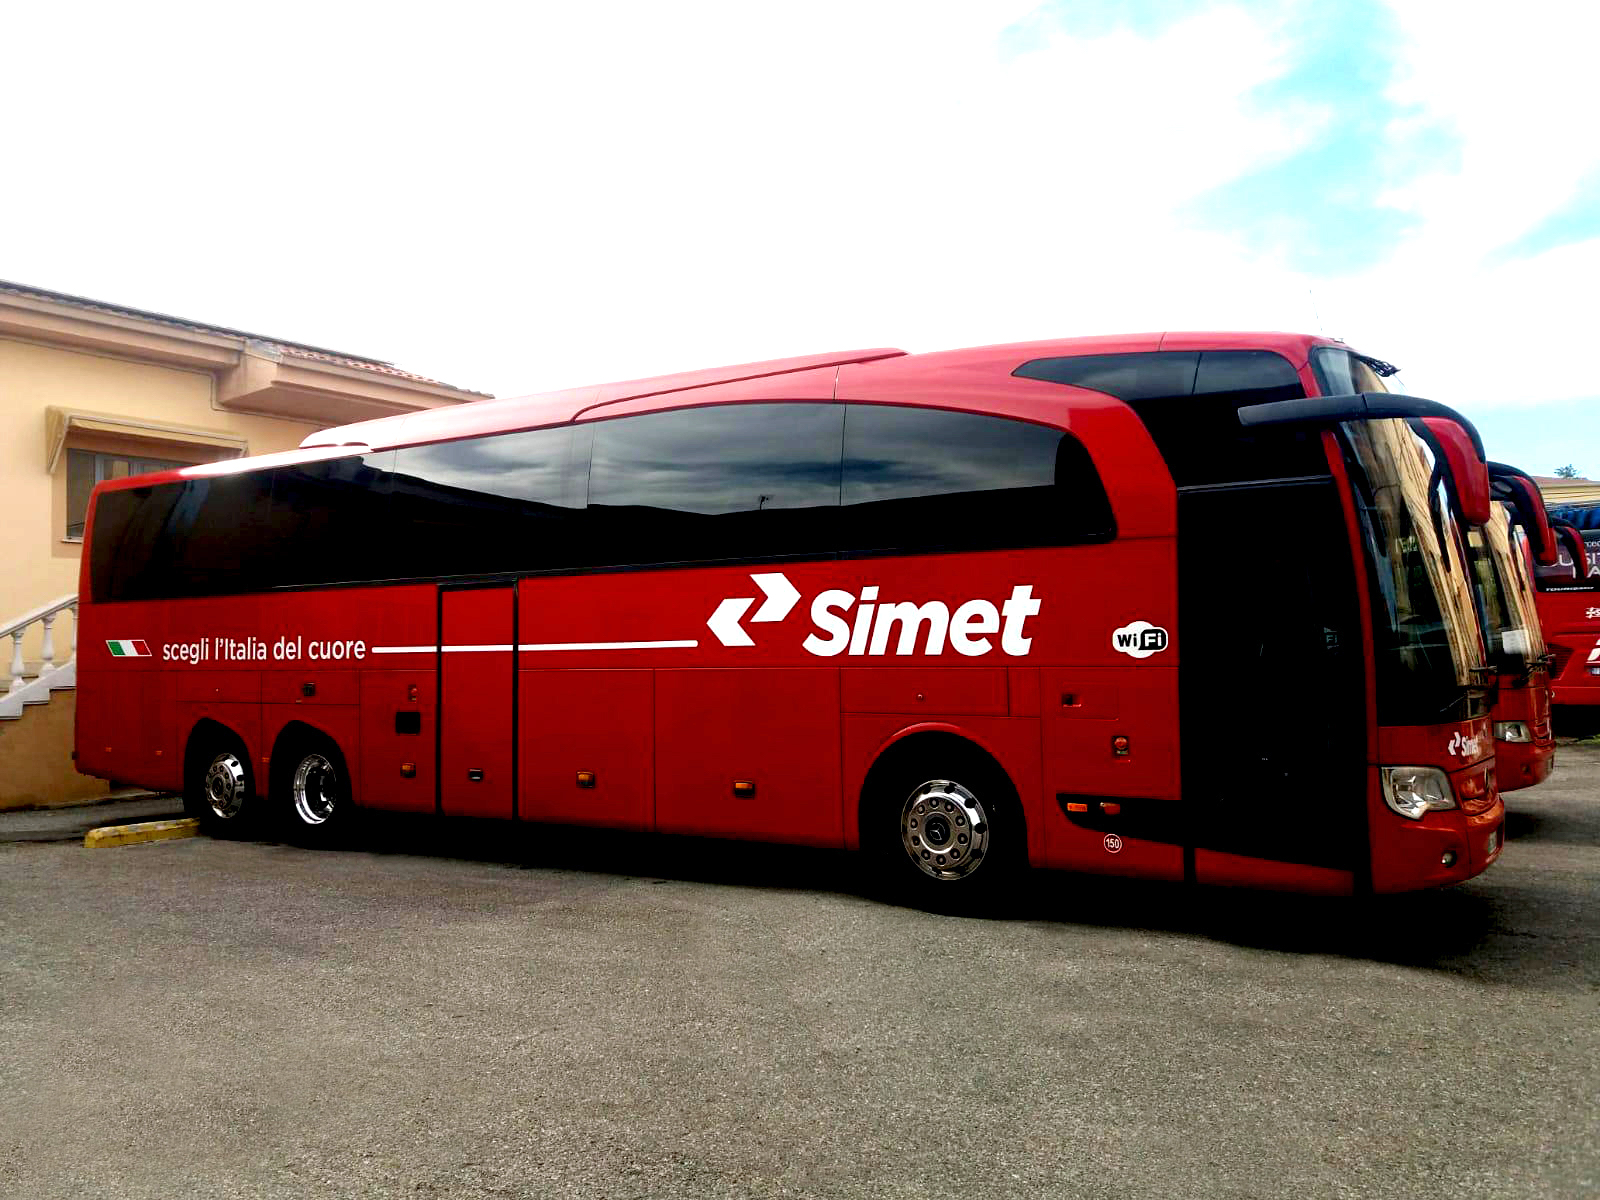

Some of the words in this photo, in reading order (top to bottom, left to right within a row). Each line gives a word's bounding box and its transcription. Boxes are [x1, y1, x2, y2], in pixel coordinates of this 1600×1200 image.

[802, 585, 1042, 657] Simet
[162, 637, 209, 665] scegli
[273, 636, 302, 660] del
[308, 640, 366, 660] cuore
[1105, 838, 1120, 849] 150
